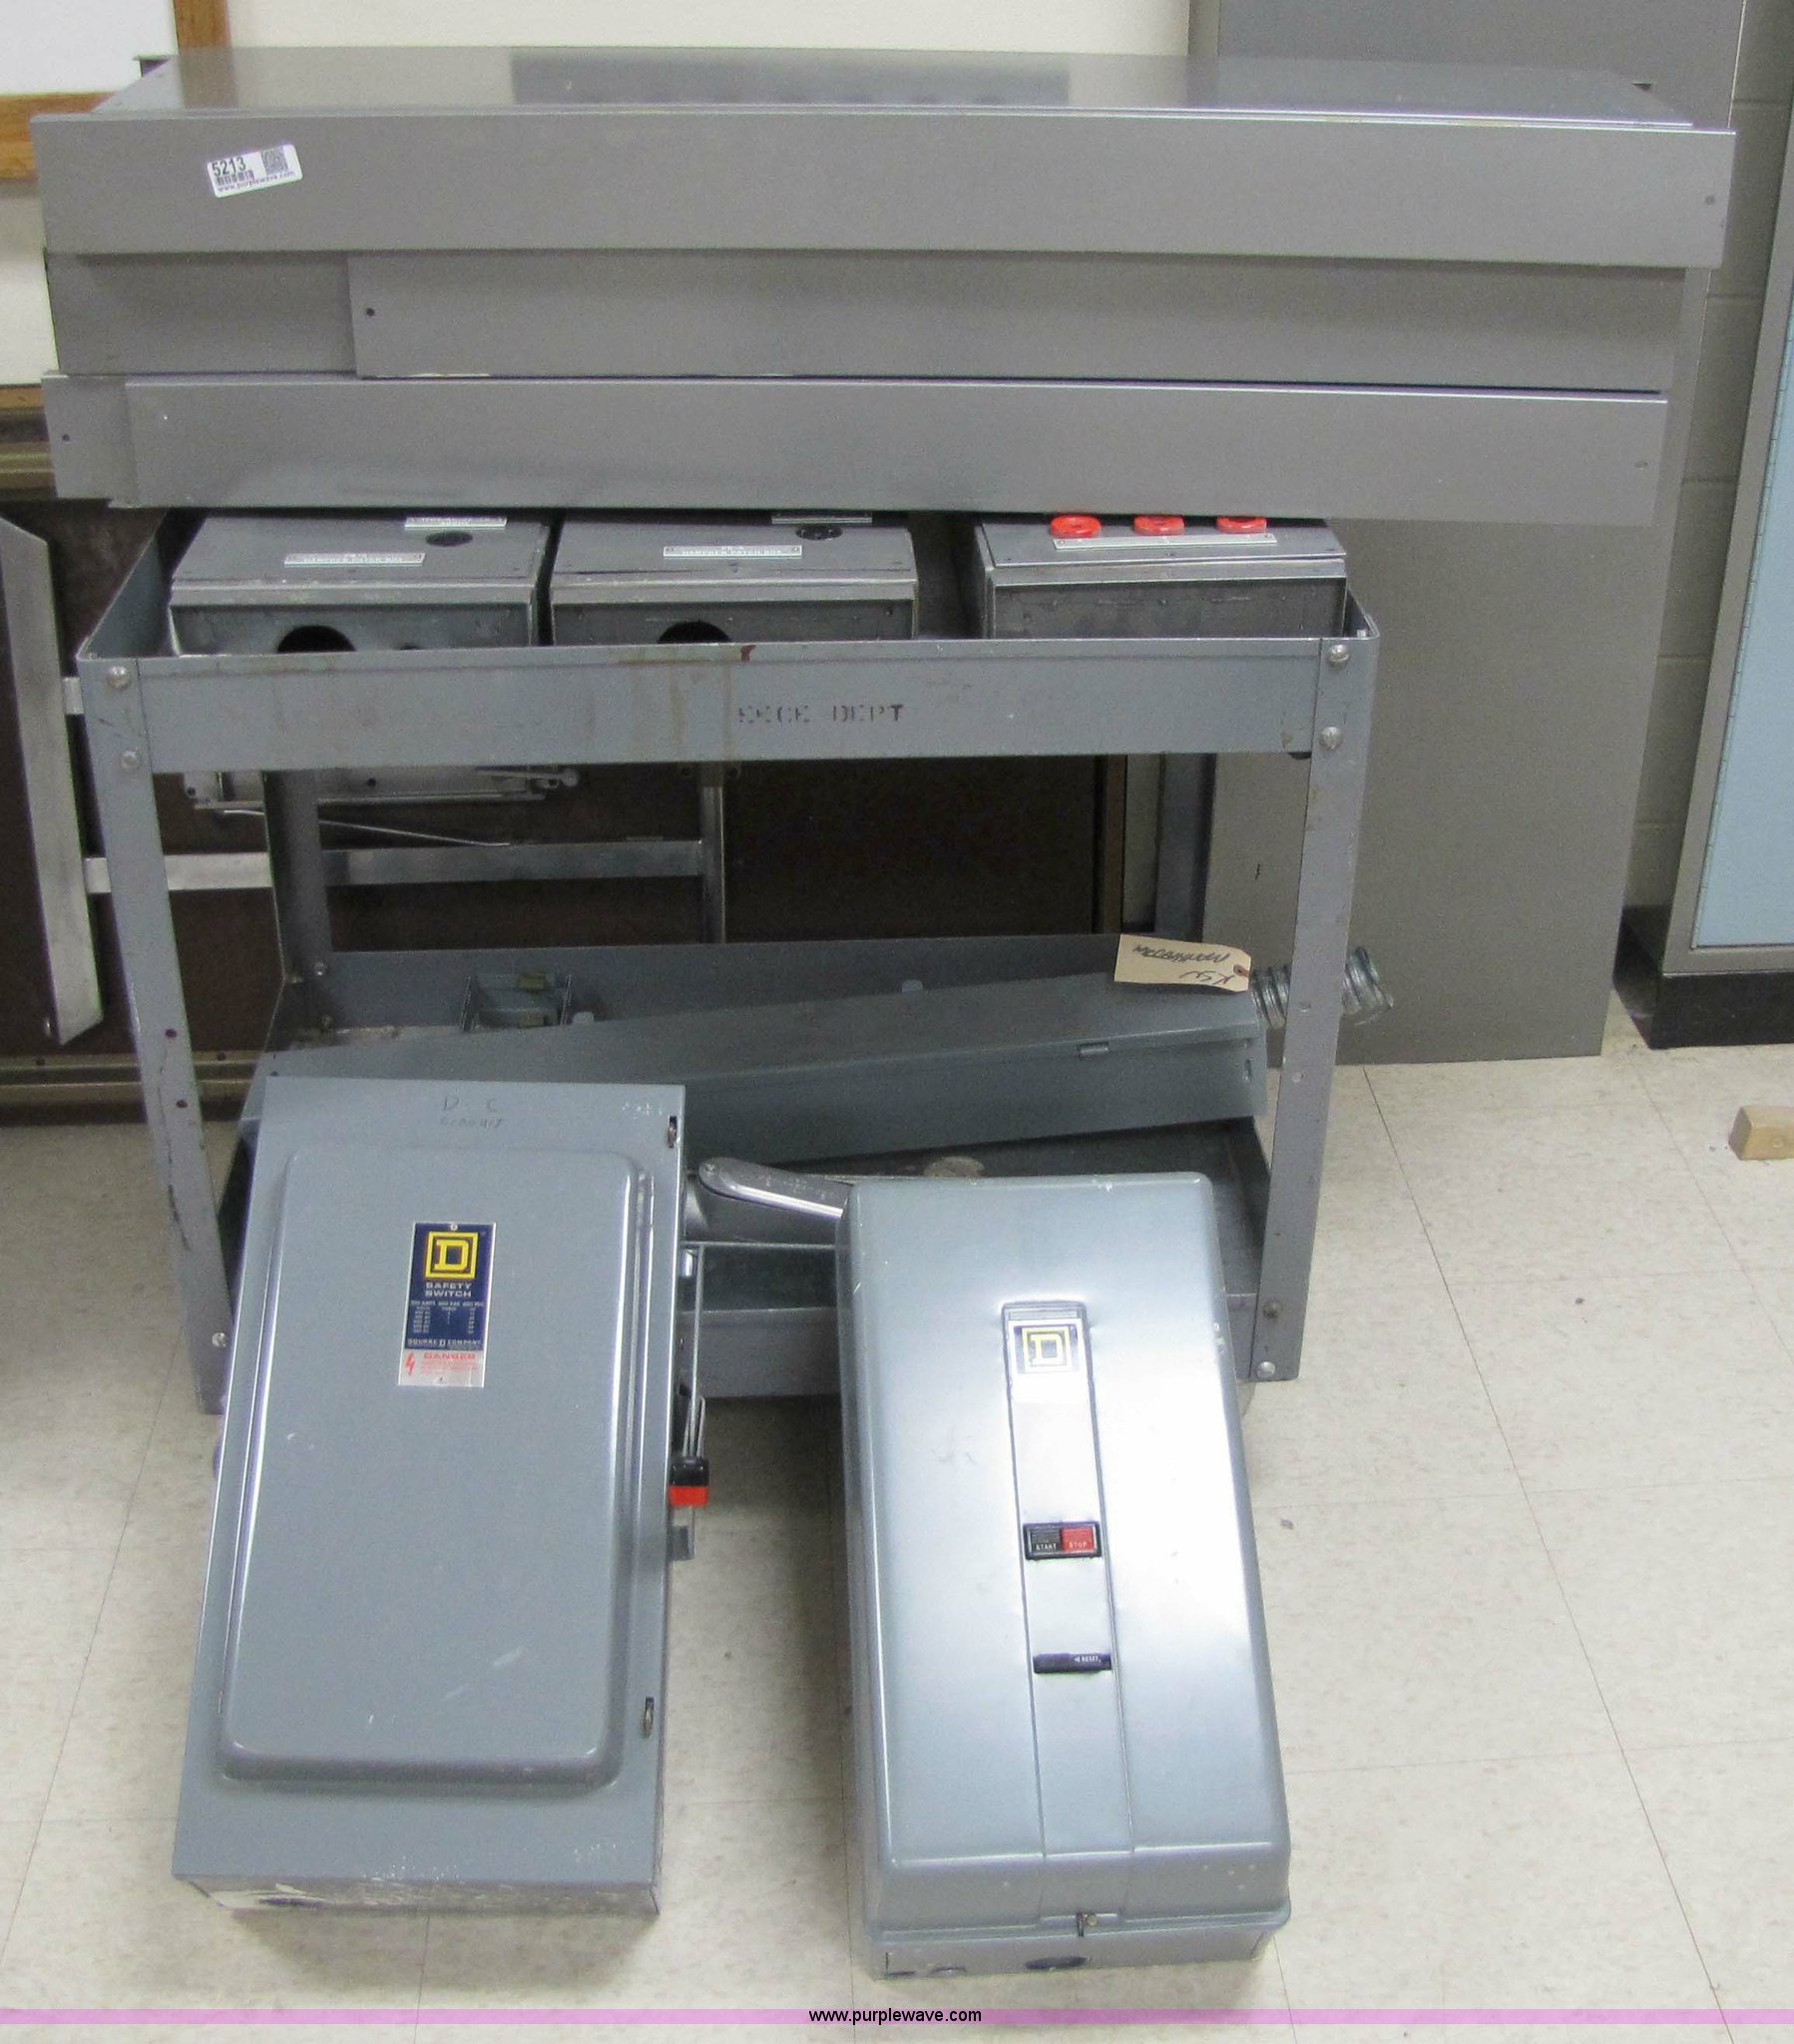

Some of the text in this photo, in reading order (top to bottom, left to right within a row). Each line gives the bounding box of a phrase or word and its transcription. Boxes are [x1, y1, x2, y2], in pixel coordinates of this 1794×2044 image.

[212, 157, 246, 177] 5213
[431, 1237, 472, 1274] D
[1036, 1540, 1089, 1551] START STOP
